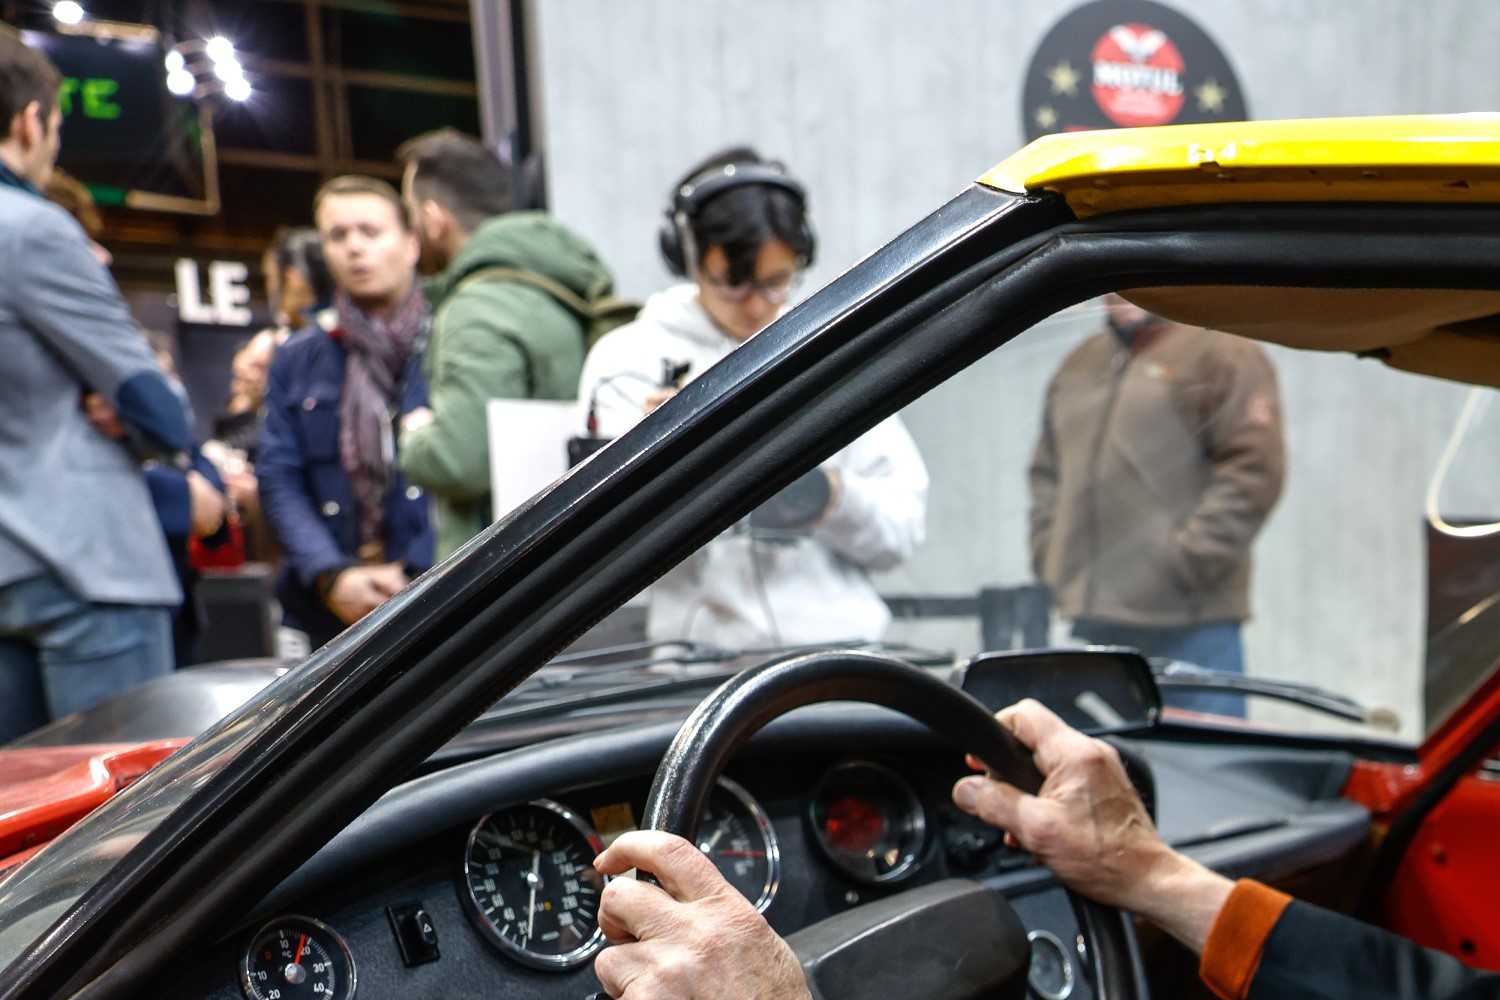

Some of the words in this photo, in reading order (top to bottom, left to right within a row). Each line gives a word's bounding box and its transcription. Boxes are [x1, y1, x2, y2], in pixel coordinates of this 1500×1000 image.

[174, 258, 252, 326] LE
[279, 939, 290, 949] 10
[264, 950, 273, 960] 0
[312, 962, 325, 974] 30
[257, 970, 268, 981] 10
[313, 981, 325, 993] 40
[268, 988, 281, 1000] 20
